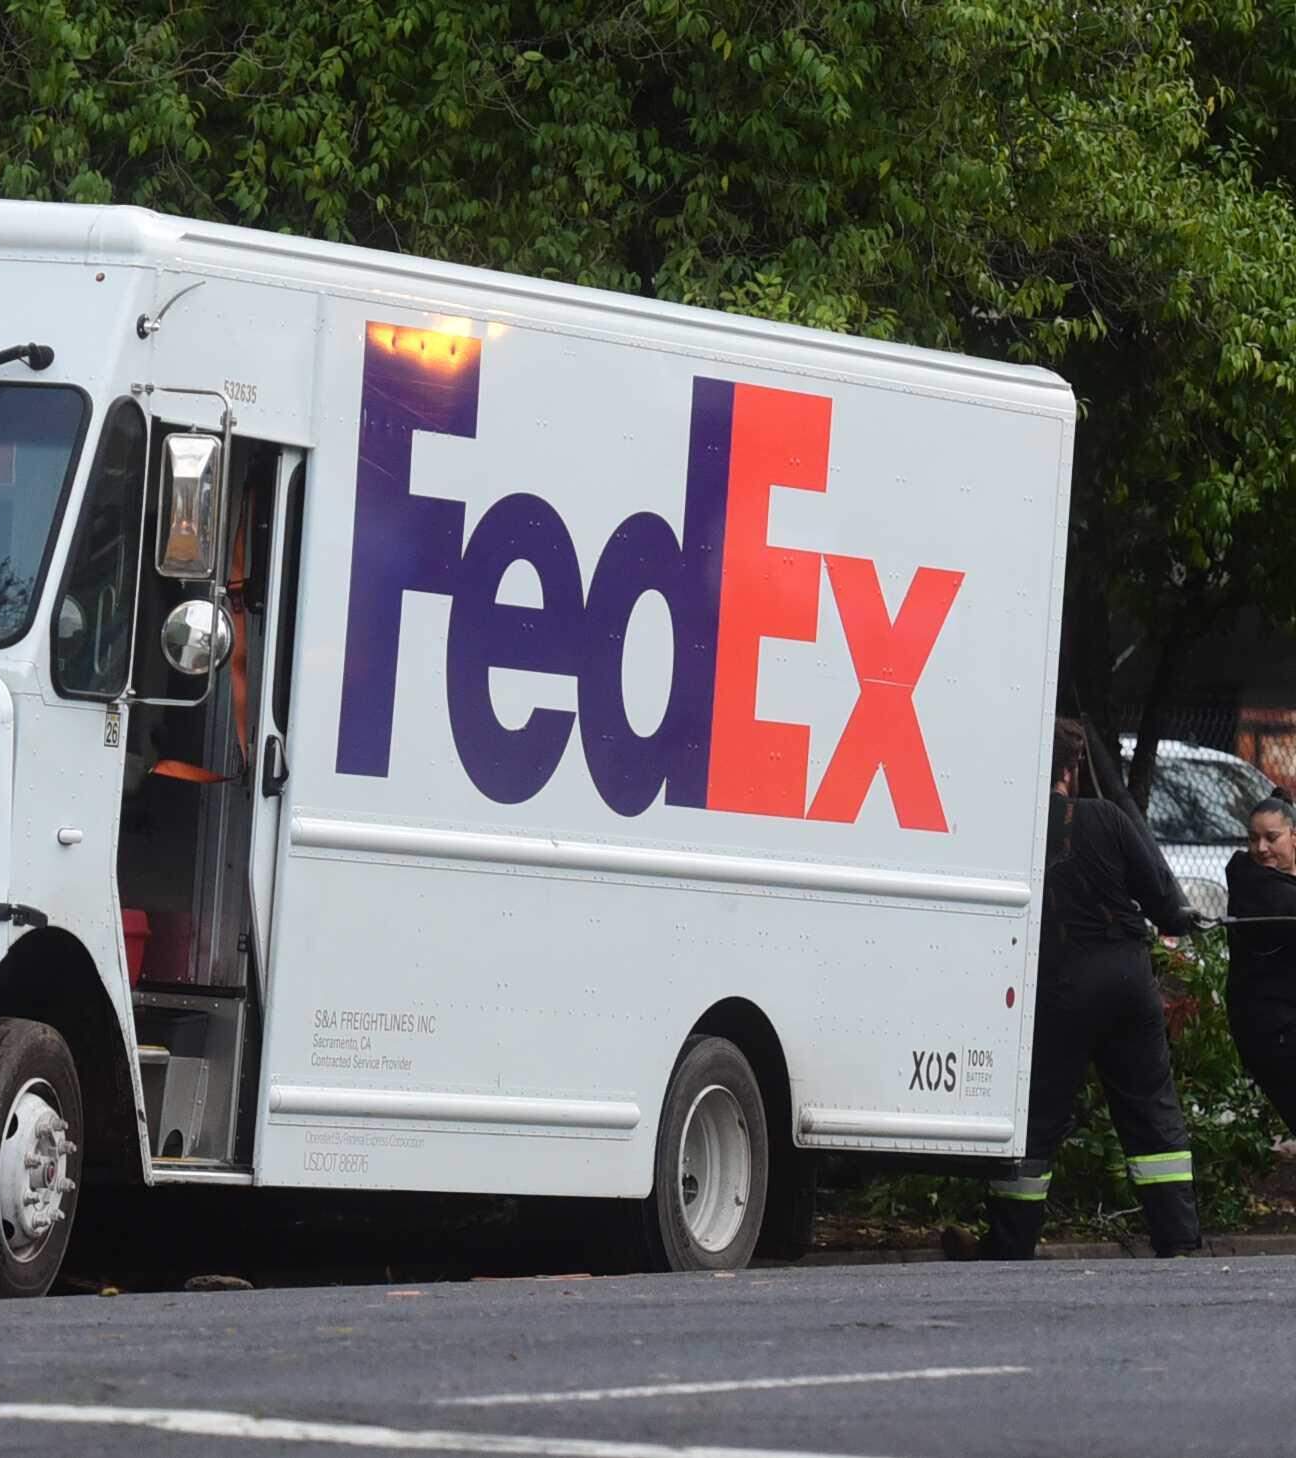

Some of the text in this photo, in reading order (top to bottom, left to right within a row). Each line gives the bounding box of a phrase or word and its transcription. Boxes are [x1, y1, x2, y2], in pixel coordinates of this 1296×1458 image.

[336, 320, 966, 833] FedEx
[106, 721, 118, 744] 26
[313, 1009, 437, 1034] S&A FREIGHTLINES INC
[312, 1033, 371, 1051] Sacramento, CA
[310, 1052, 412, 1071] Contracted Service Provider
[967, 1049, 993, 1068] 100%
[909, 1051, 957, 1092] XOS
[966, 1072, 992, 1084] BATTERY
